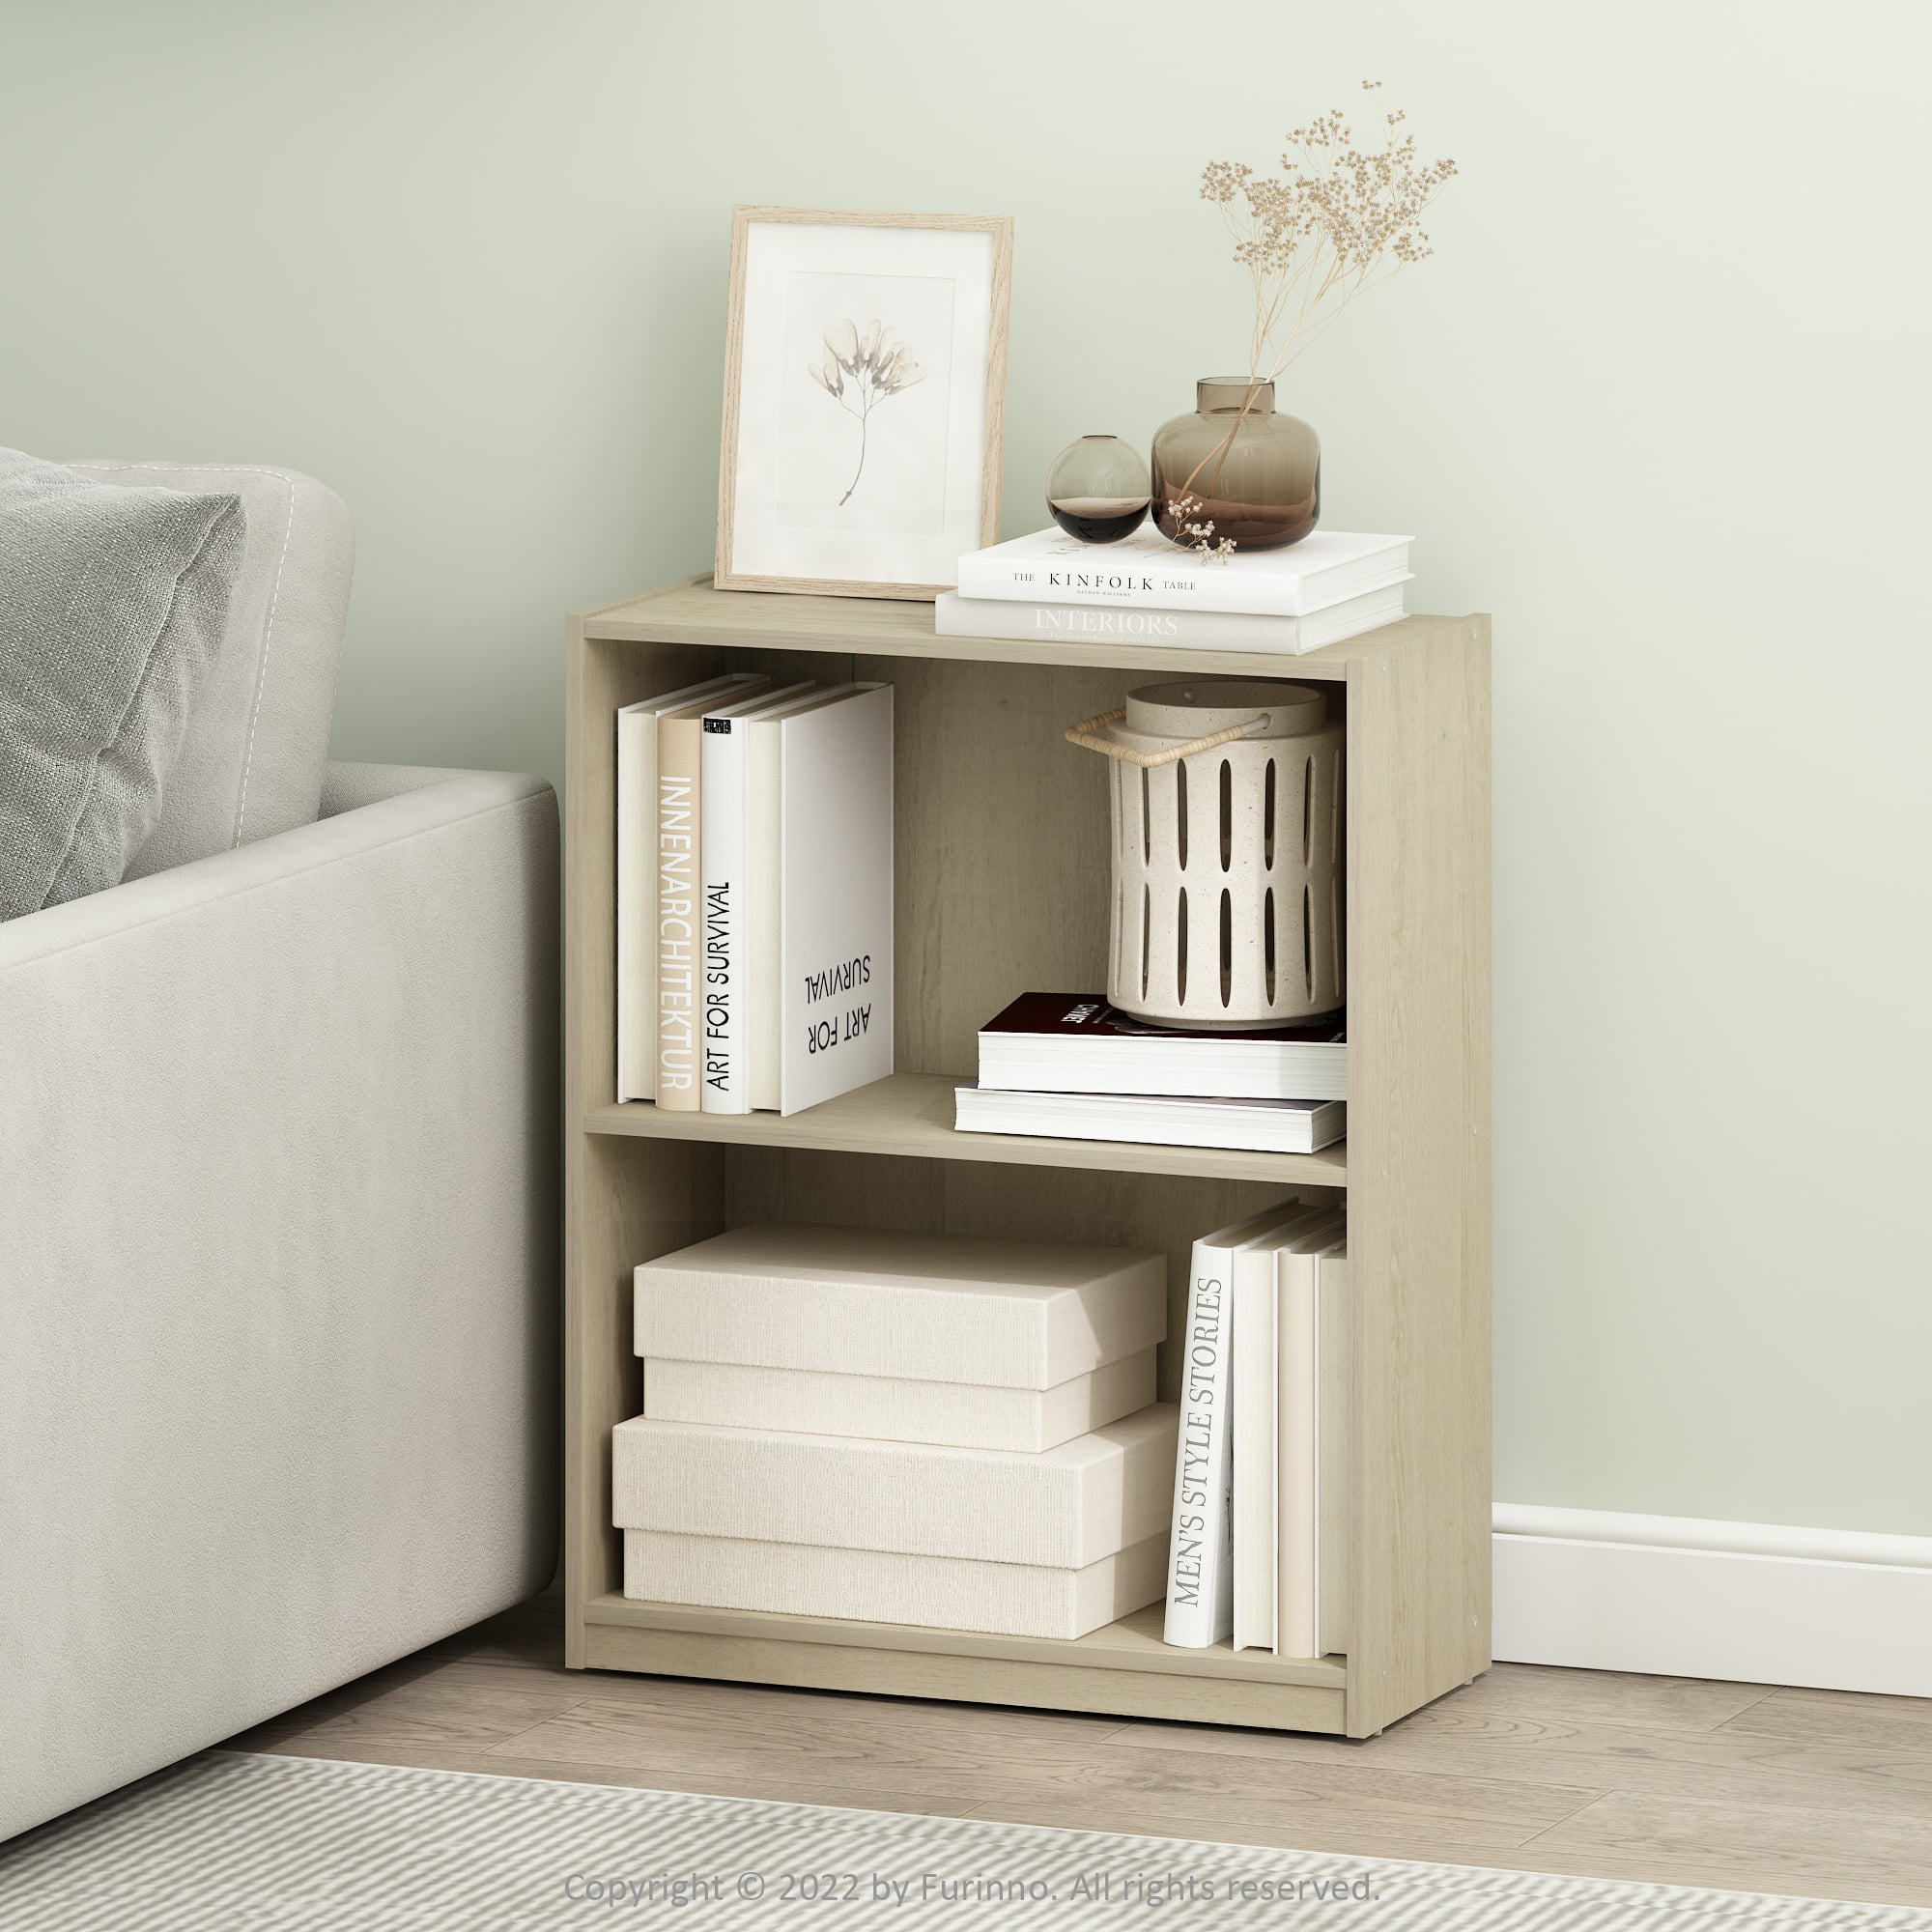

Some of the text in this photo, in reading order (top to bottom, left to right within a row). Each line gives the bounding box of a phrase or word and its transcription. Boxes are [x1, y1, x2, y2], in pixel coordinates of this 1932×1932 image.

[1012, 573, 1197, 591] THE KINFOLK TABLE
[1035, 609, 1178, 636] INTERIORS
[660, 776, 692, 1091] INNENARCHITEKTUR
[707, 882, 730, 1091] ART FOR SURVIVAL
[805, 954, 871, 1005] SURVIVAL
[809, 1003, 871, 1055] ART FOR
[1174, 1276, 1223, 1607] MEN'S STYLE STORIES
